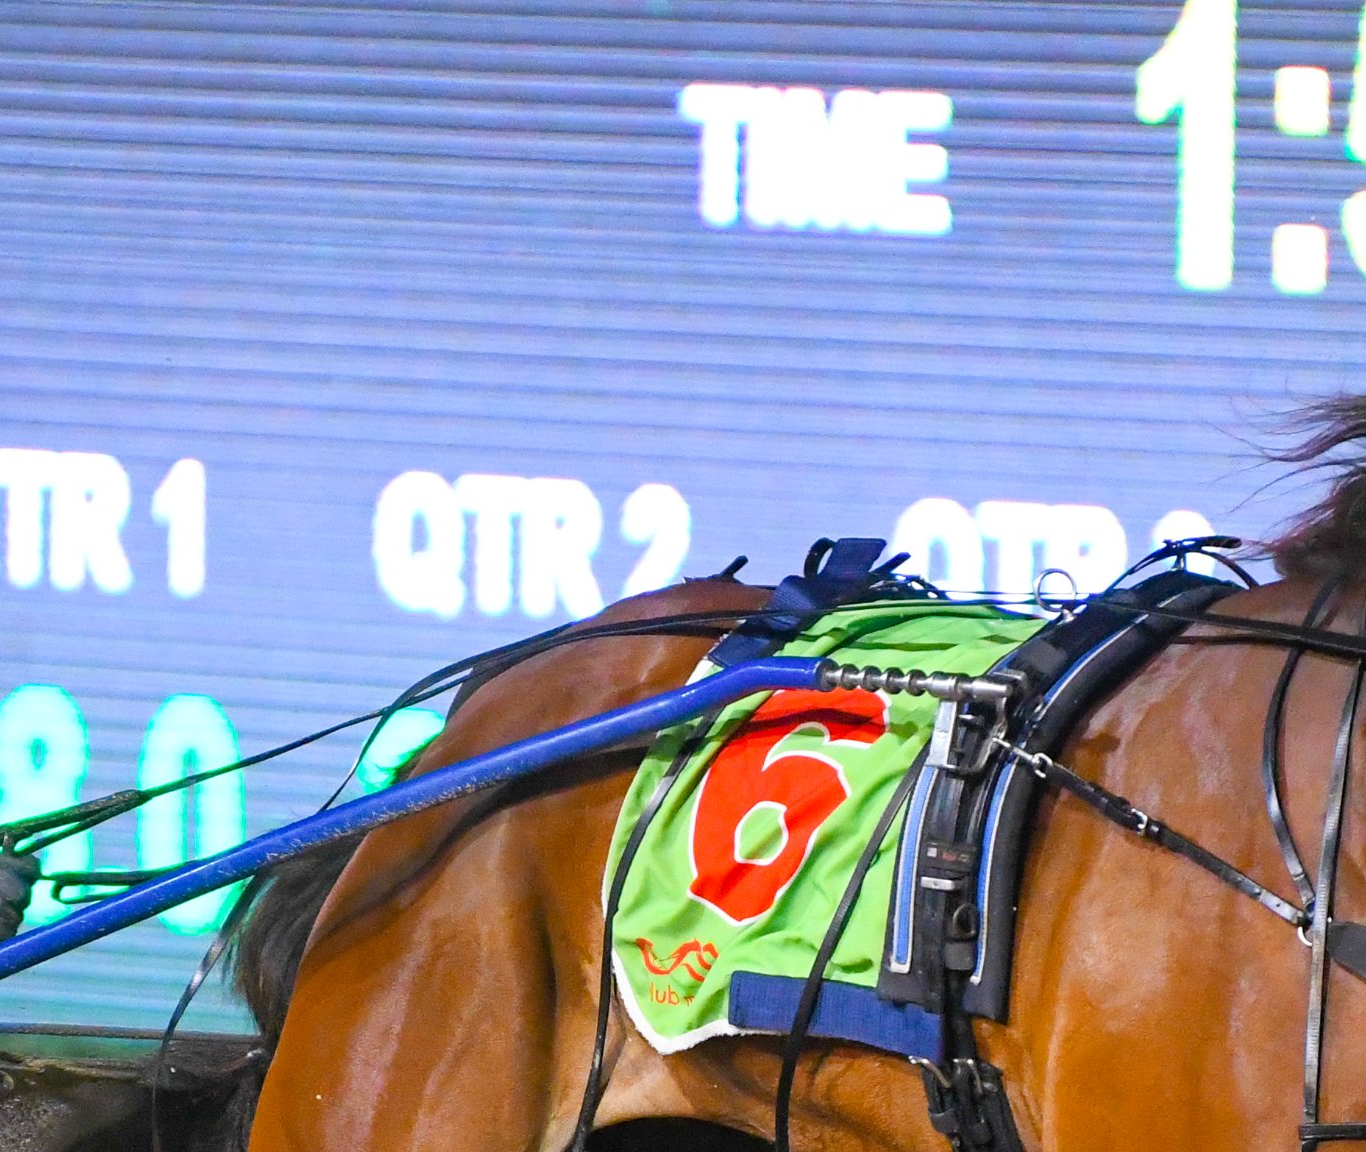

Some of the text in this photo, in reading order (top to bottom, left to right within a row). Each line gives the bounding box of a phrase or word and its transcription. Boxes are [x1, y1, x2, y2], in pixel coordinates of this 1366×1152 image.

[151, 457, 208, 598] 1
[372, 470, 693, 621] QTR 2
[687, 686, 893, 928] 6
